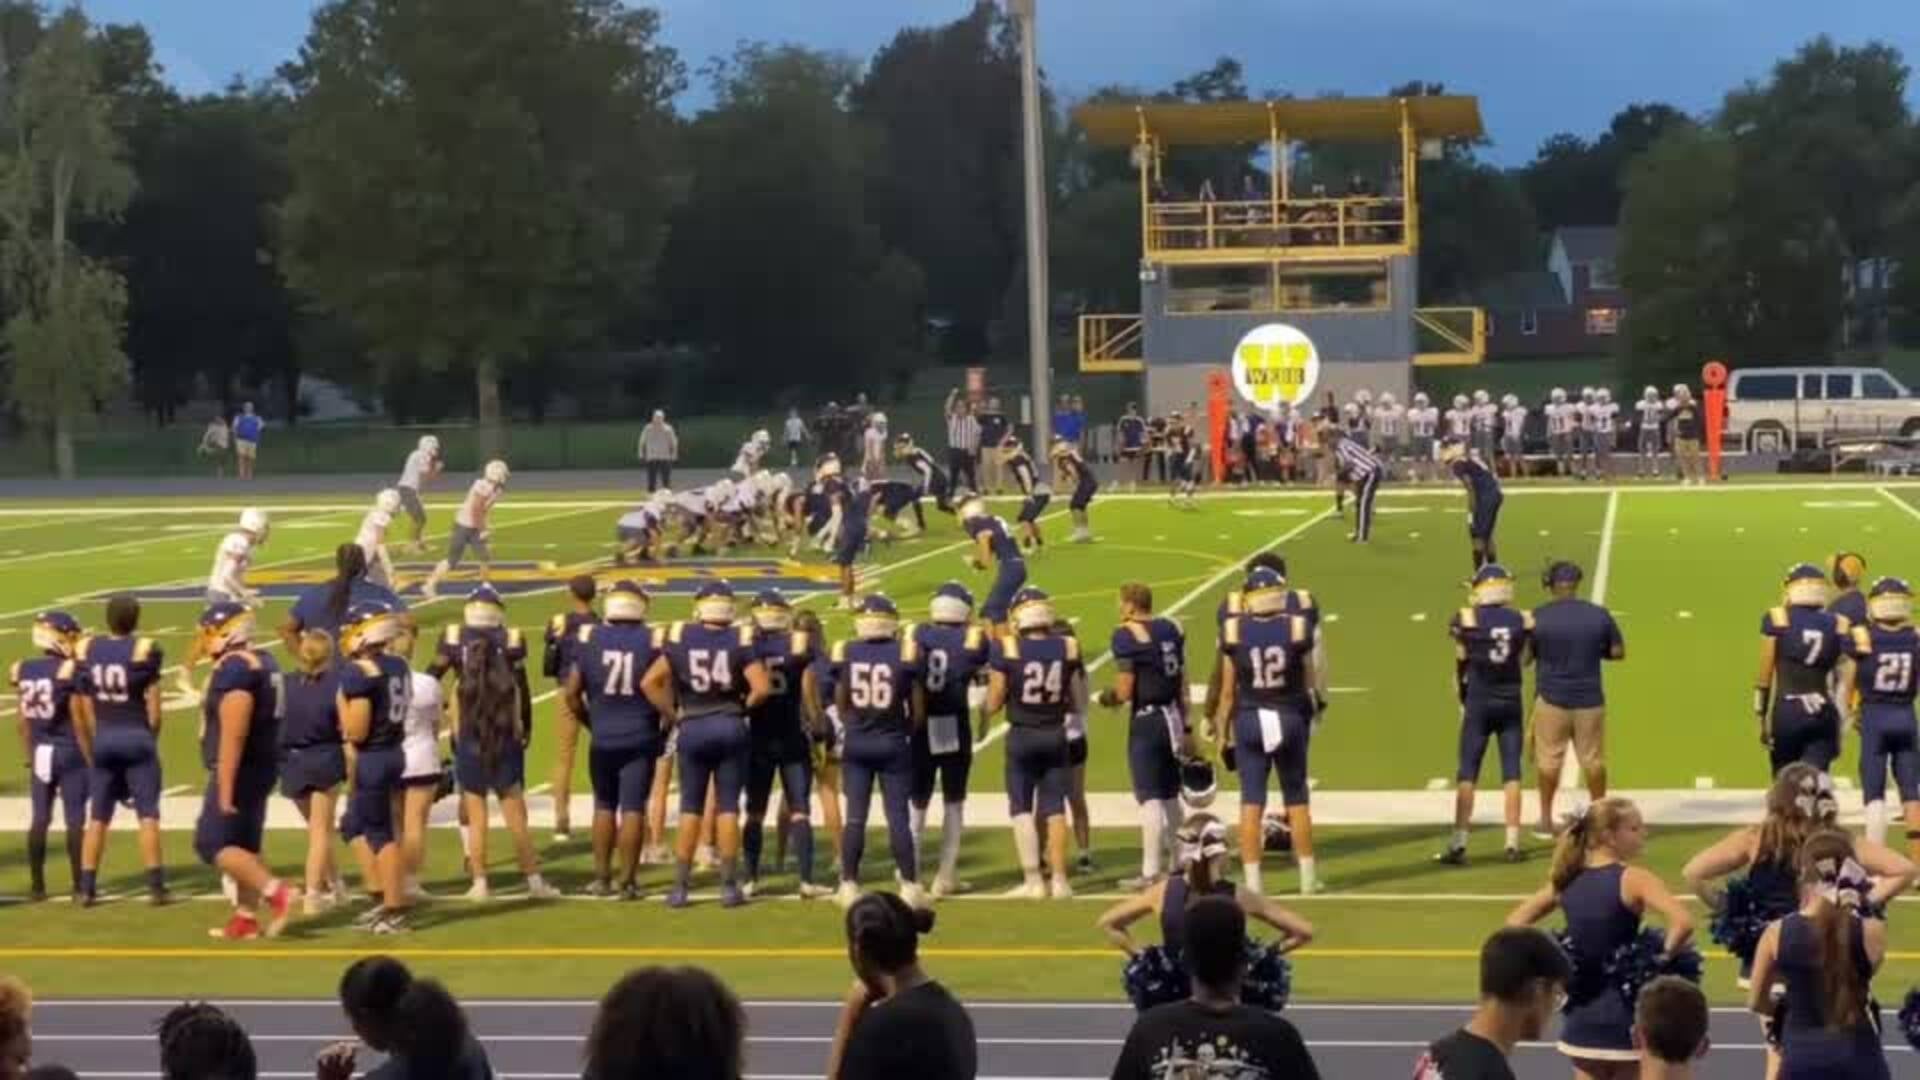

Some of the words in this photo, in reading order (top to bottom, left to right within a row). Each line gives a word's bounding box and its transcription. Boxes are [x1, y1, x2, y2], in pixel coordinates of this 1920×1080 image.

[1490, 627, 1510, 662] 3
[1803, 629, 1823, 664] 7
[92, 664, 129, 701] 10
[602, 651, 635, 695] 71
[688, 650, 732, 692] 54
[851, 662, 893, 709] 56
[926, 649, 948, 691] 8
[1022, 661, 1063, 703] 24
[1250, 646, 1286, 688] 12
[1875, 653, 1912, 691] 21
[20, 678, 55, 719] 23
